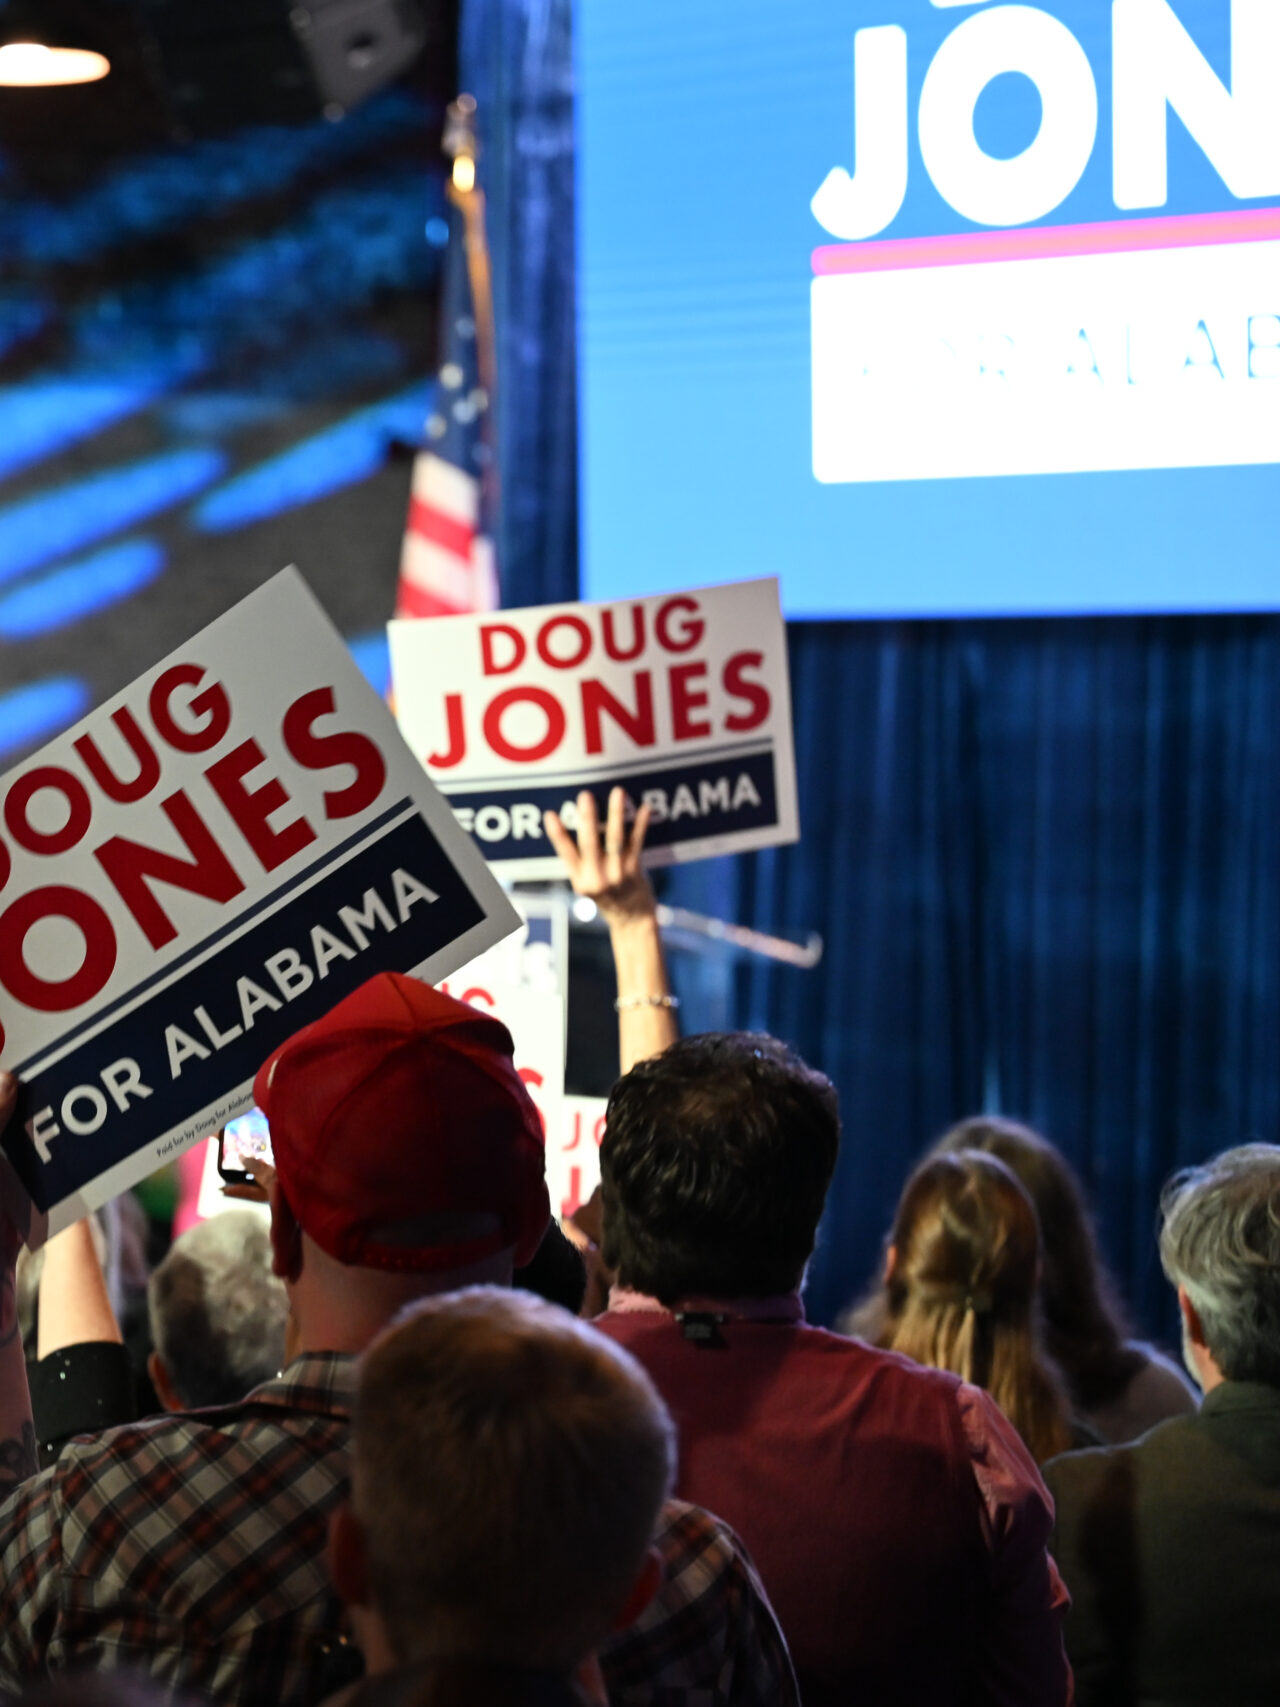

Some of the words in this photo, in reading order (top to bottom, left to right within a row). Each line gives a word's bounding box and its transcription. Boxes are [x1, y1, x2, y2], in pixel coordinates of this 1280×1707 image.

[479, 596, 706, 677] DOUG
[427, 651, 772, 769] JONES
[24, 1056, 154, 1165] FOR
[163, 868, 439, 1080] ALABAMA
[157, 1141, 173, 1157] Paid
[195, 1118, 217, 1133] Doug
